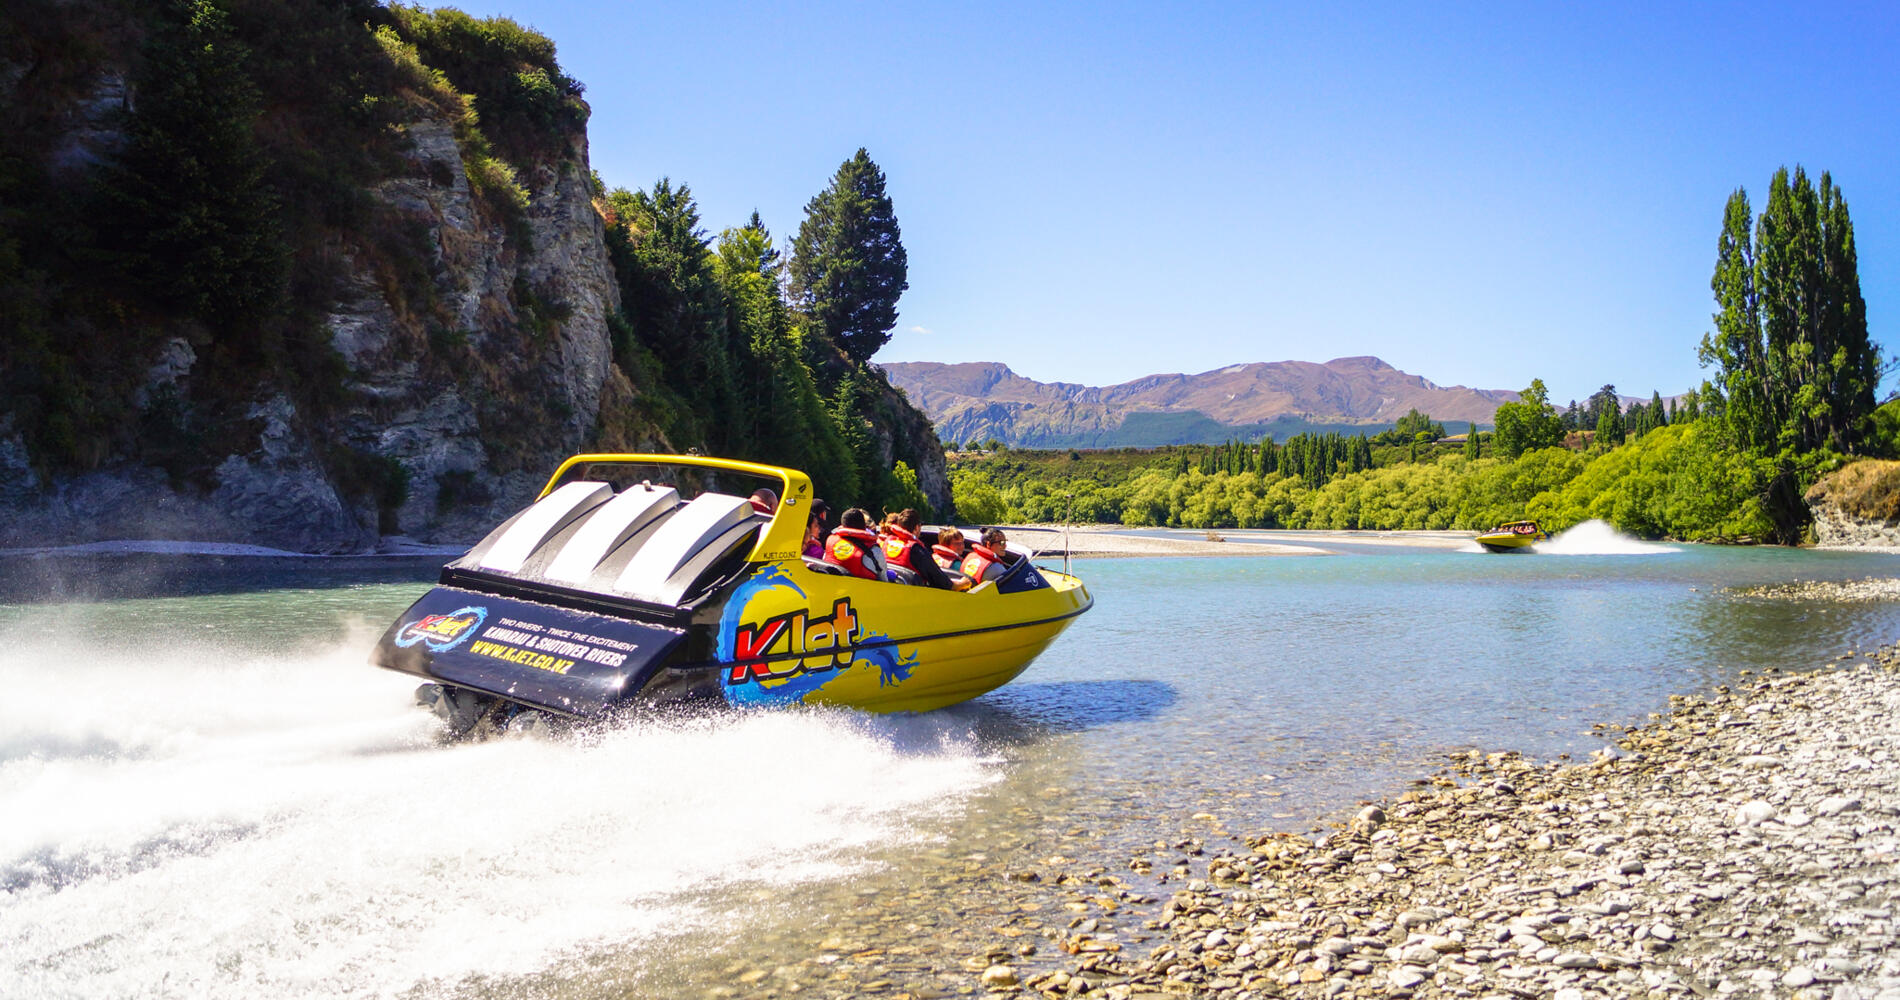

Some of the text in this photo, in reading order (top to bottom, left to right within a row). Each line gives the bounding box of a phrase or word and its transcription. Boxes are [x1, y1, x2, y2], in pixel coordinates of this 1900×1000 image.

[482, 626, 627, 667] KAWARAU & SHOTOVER RIVERS
[498, 617, 517, 627] TWO
[514, 621, 543, 632] RIVERS
[547, 627, 573, 638] TWICE
[571, 632, 589, 642] THE
[586, 635, 639, 652] EXCITEMENT
[469, 640, 575, 675] WWW.KJET.CO.NZ
